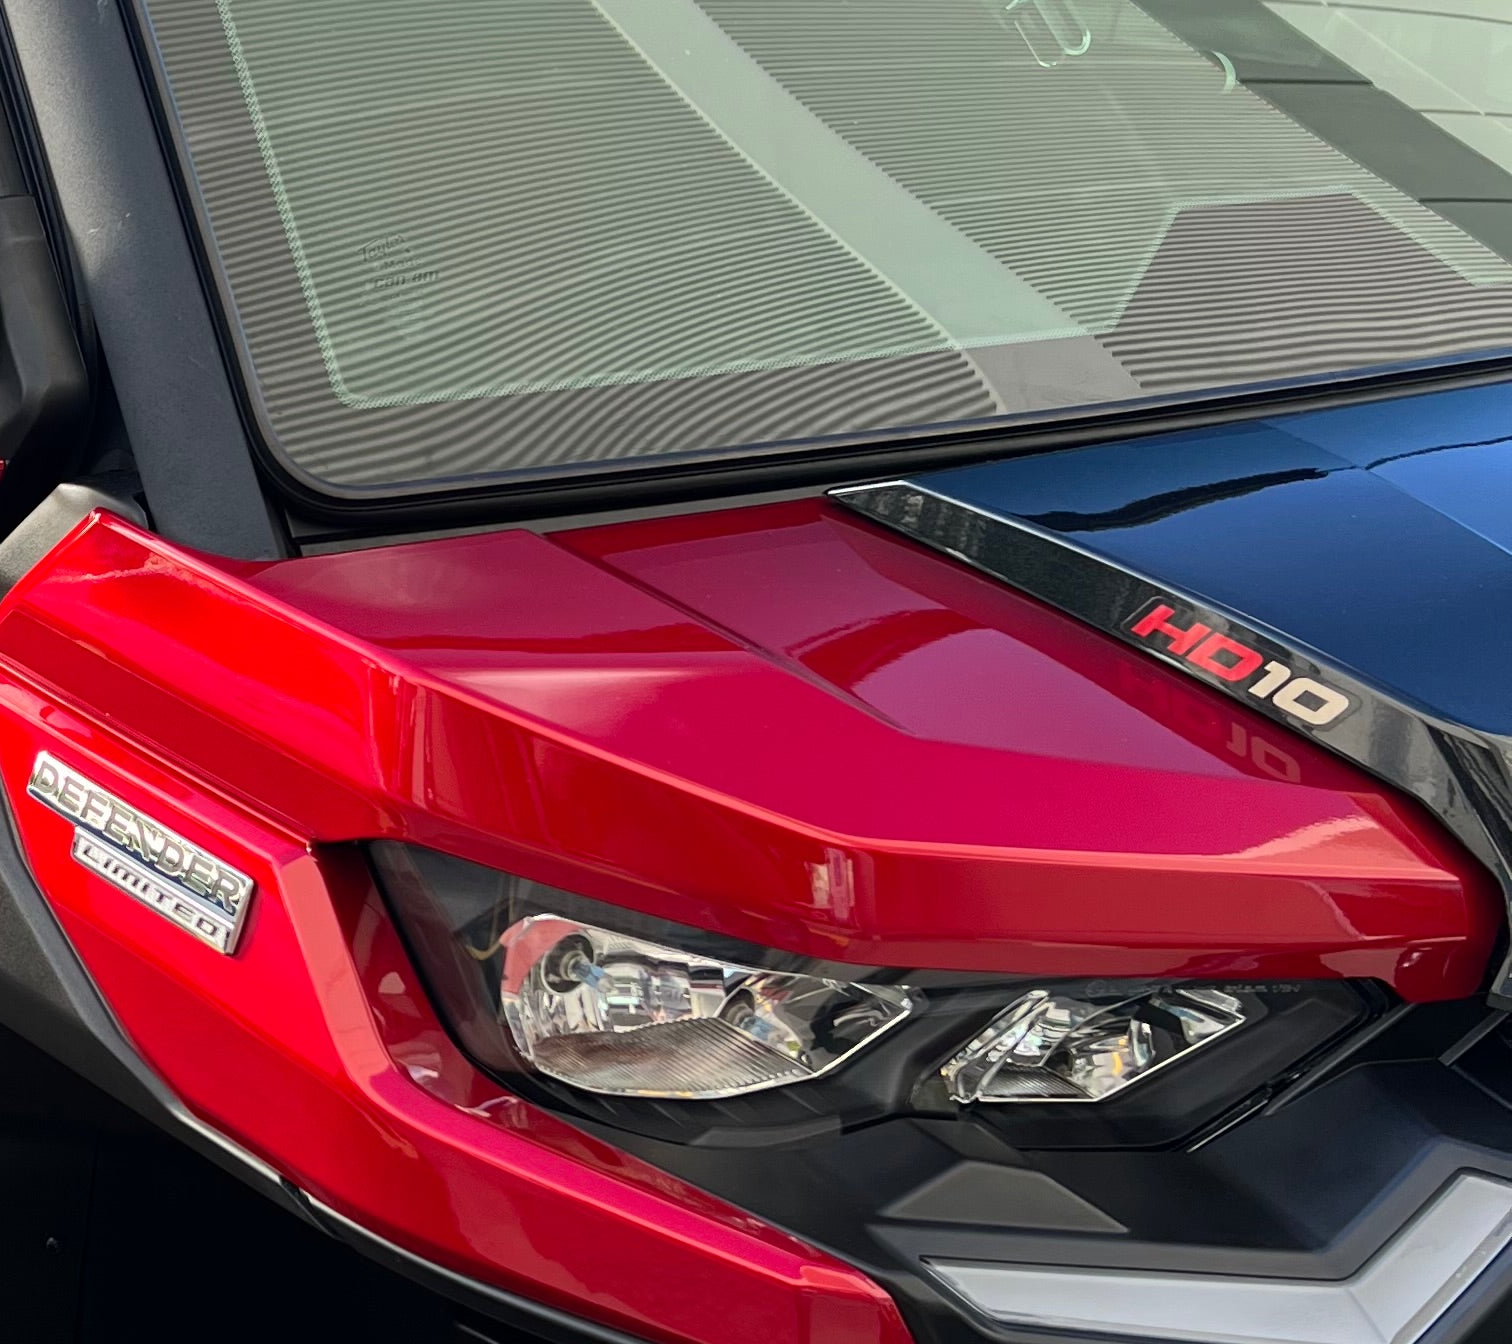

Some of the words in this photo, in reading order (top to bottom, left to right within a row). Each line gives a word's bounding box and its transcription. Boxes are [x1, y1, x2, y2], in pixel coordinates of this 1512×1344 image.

[1131, 604, 1349, 725] HD10
[33, 760, 242, 914] DEFENDER
[82, 843, 219, 939] LIMITED
